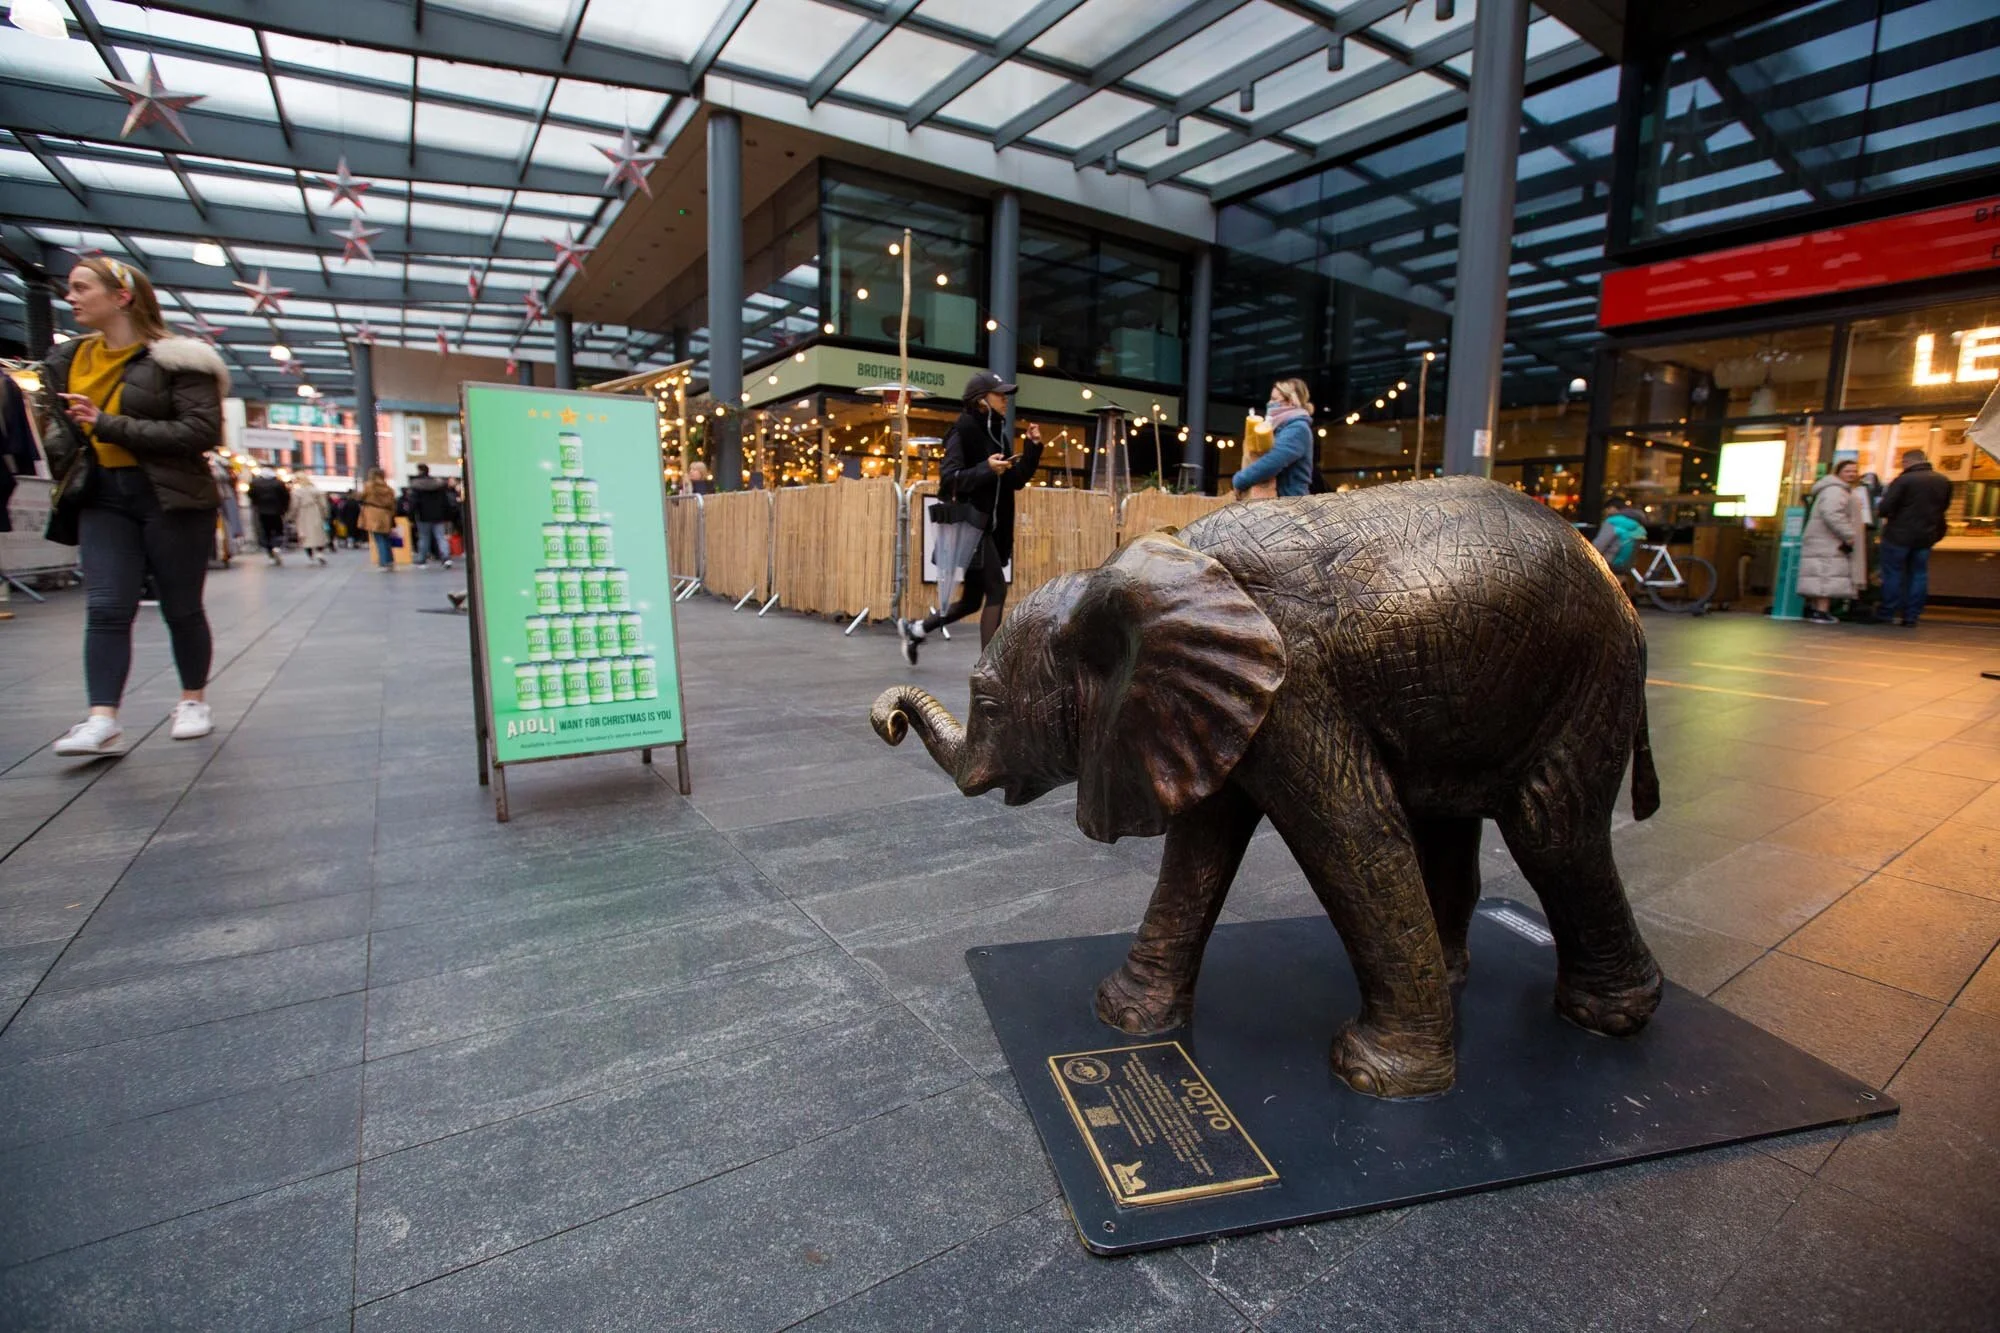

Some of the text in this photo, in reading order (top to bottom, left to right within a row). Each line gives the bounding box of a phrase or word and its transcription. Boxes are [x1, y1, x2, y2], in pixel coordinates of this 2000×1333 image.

[857, 362, 945, 386] BROTHER MARCUS
[1912, 325, 2000, 386] LE
[507, 715, 556, 739] AIOLI
[559, 718, 582, 731] WANT
[585, 716, 600, 728] FOR
[602, 712, 646, 726] CHRISTMAS
[648, 710, 656, 721] IS
[657, 708, 672, 720] YOU
[1180, 1078, 1231, 1130] JOTTO
